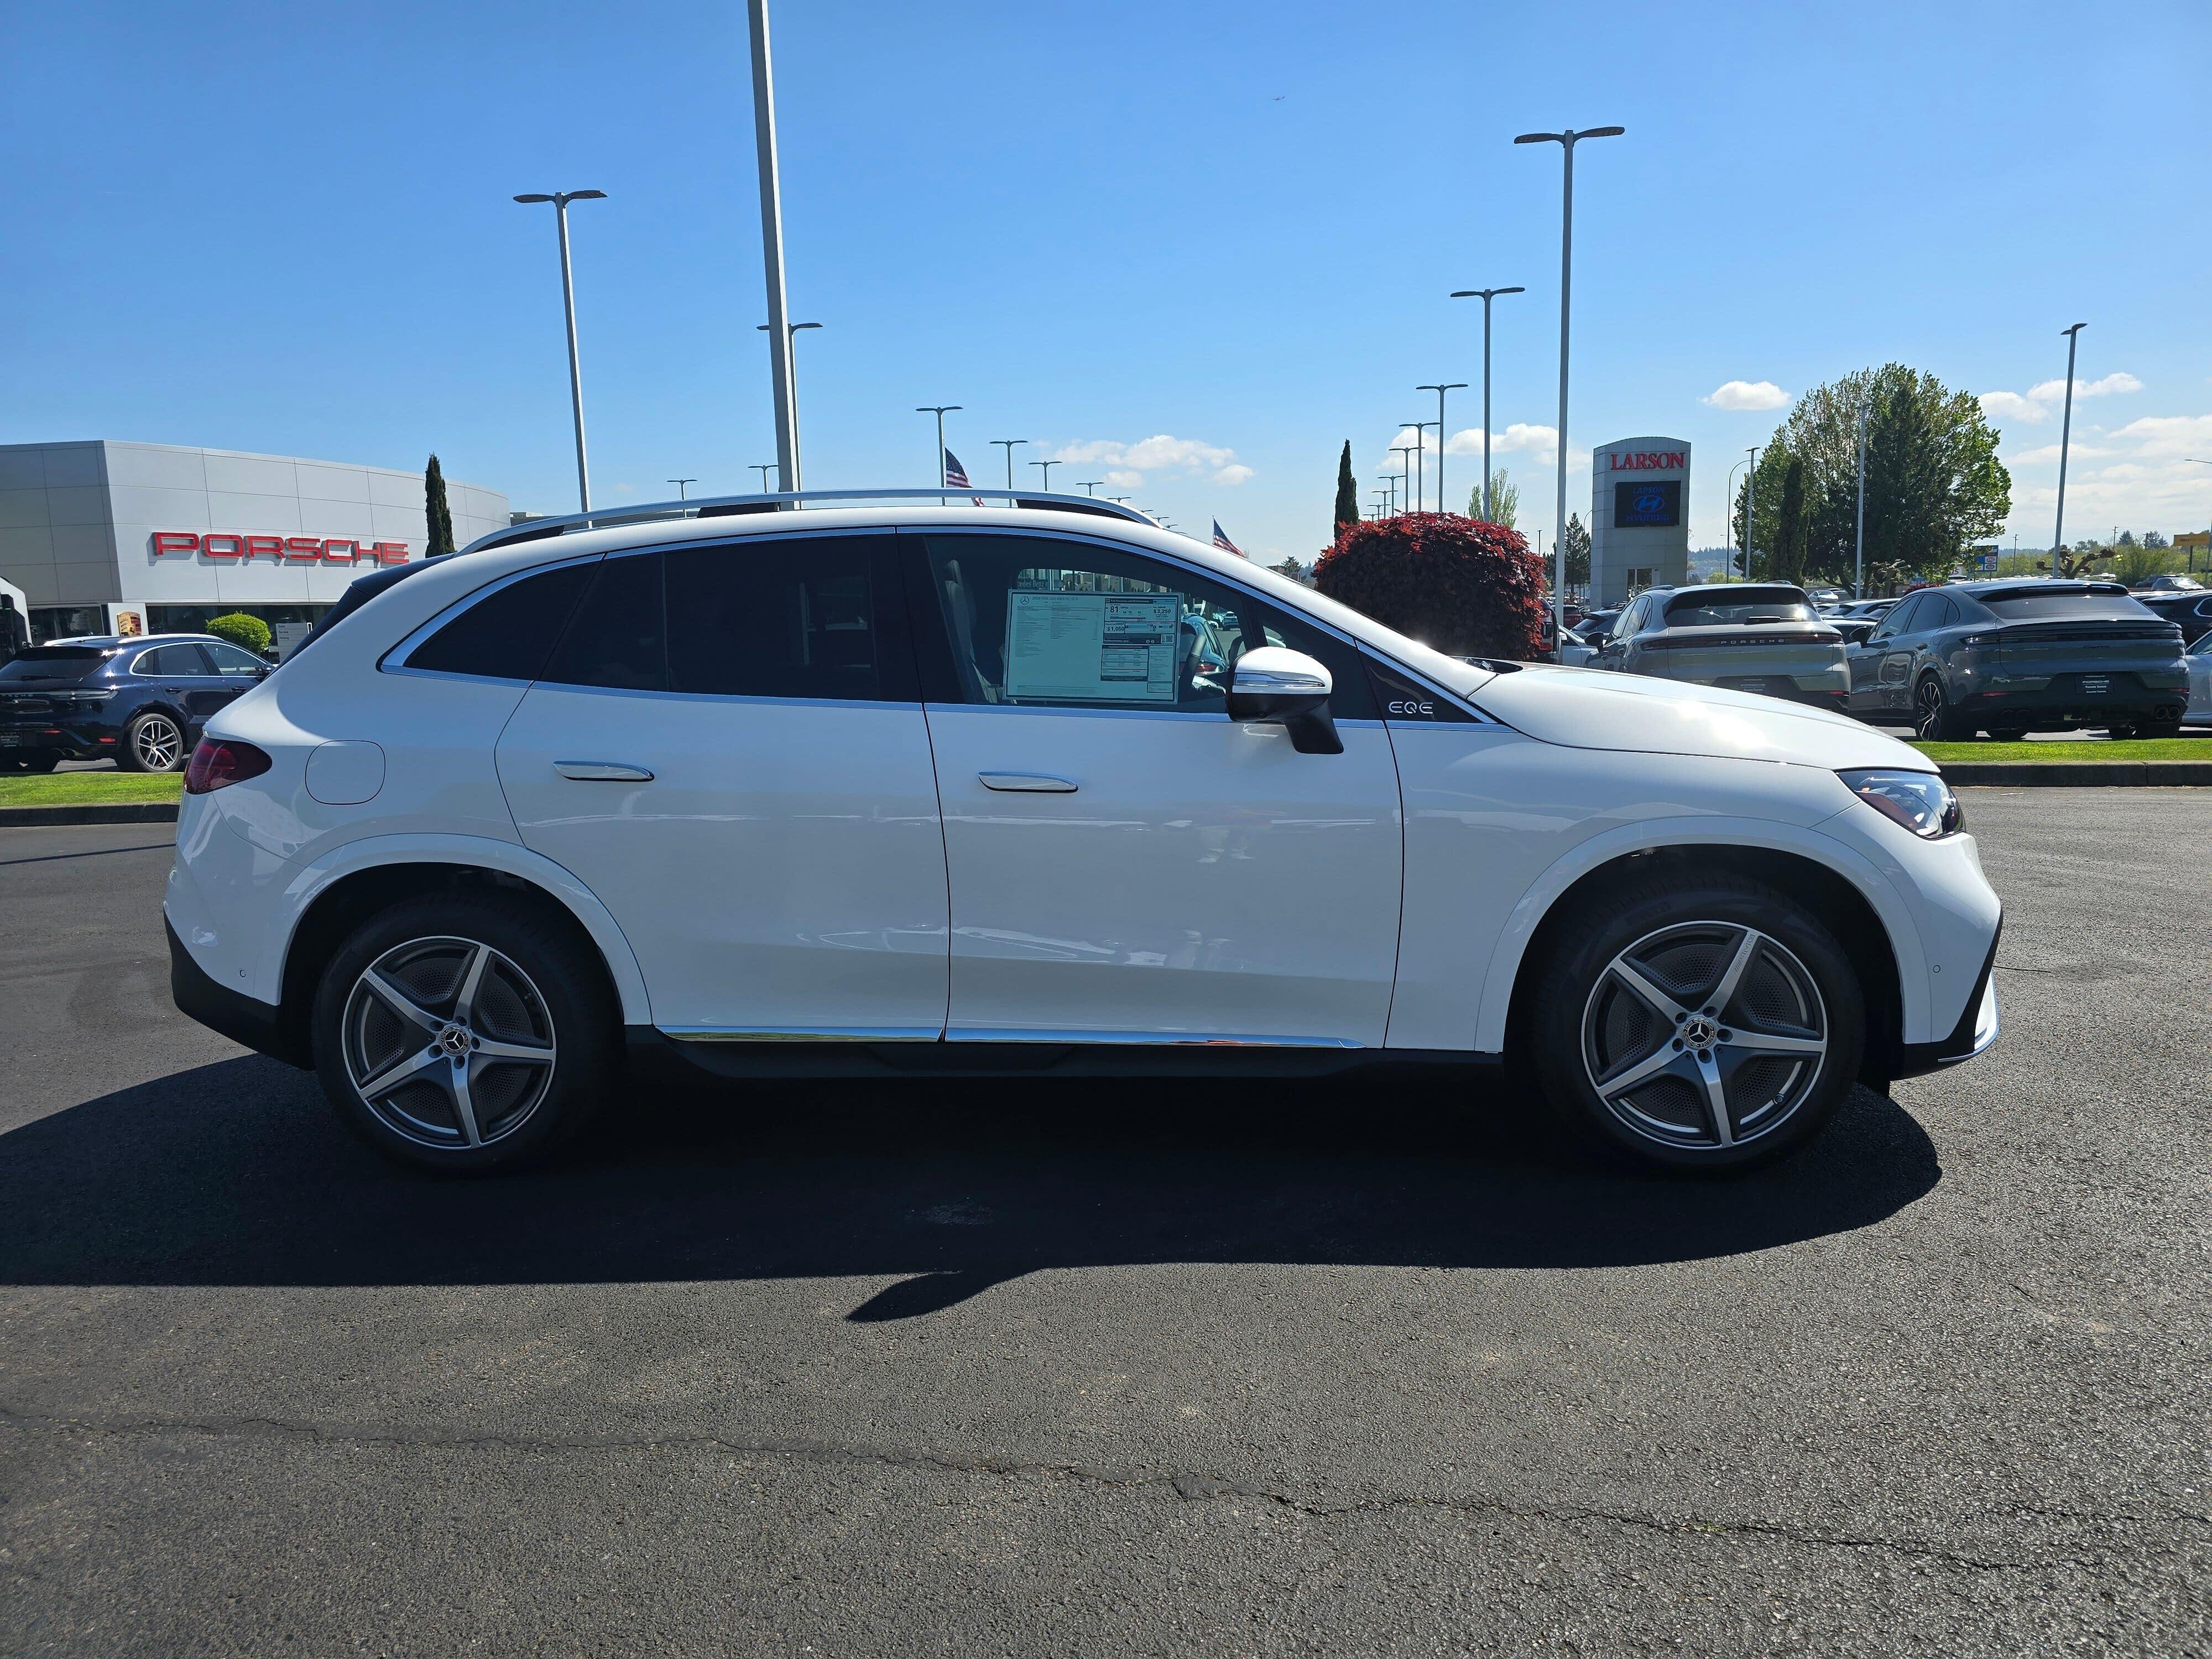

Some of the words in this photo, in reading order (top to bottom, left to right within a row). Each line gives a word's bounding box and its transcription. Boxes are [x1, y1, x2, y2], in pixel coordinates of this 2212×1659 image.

[1610, 452, 1686, 471] LARSON
[155, 531, 410, 564] PORSCHE
[1389, 701, 1433, 714] EQE
